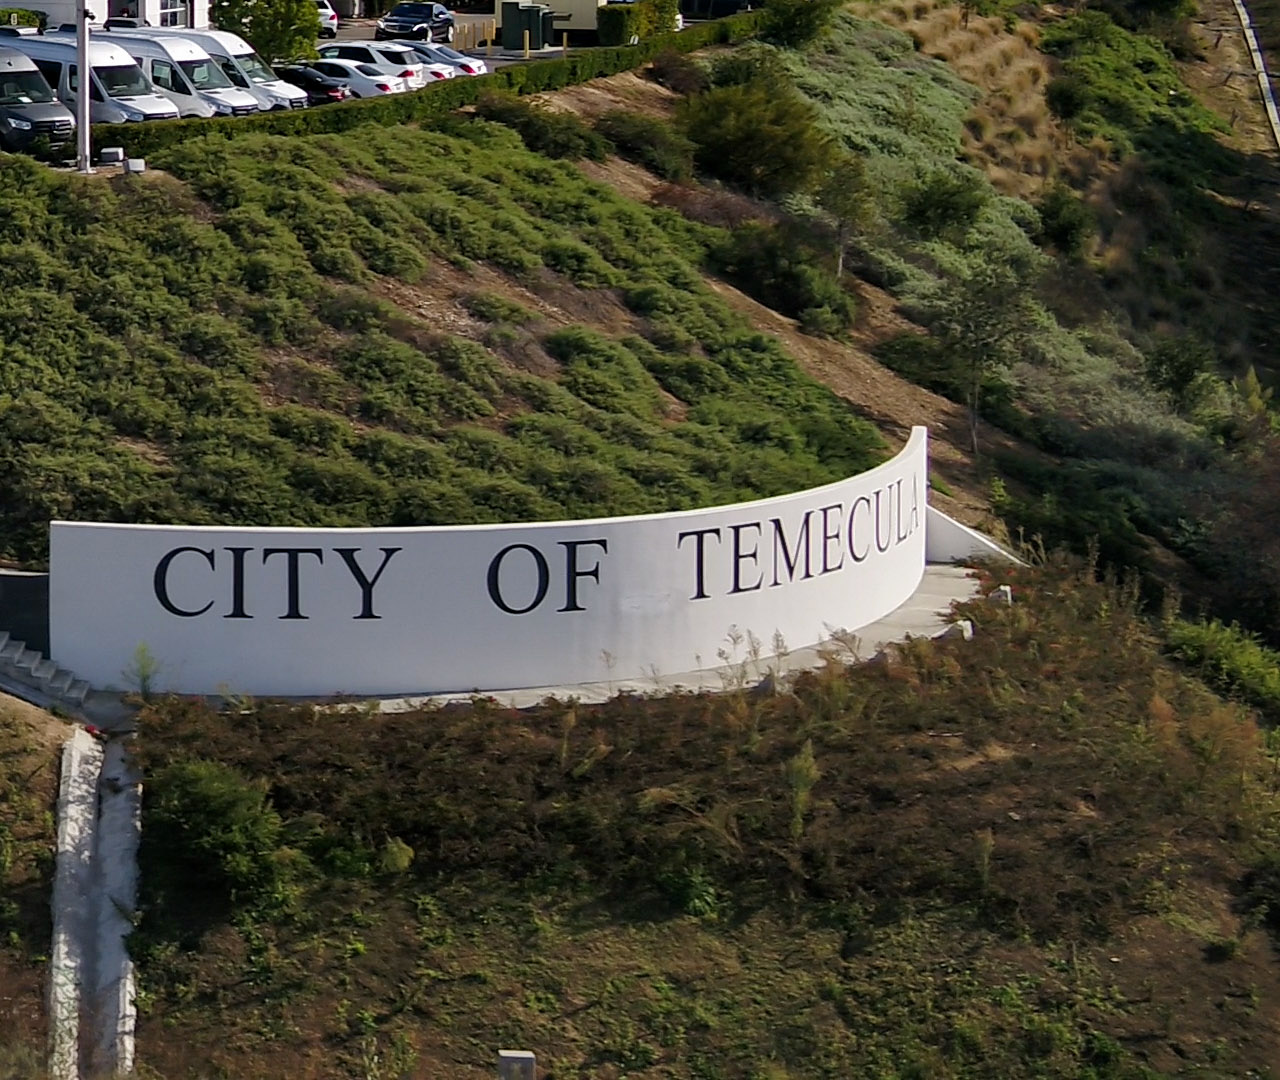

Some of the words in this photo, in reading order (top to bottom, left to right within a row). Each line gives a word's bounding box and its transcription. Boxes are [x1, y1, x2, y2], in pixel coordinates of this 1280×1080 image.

[151, 545, 405, 621] CITY
[485, 537, 610, 616] OF
[676, 472, 920, 602] TEMECULA
